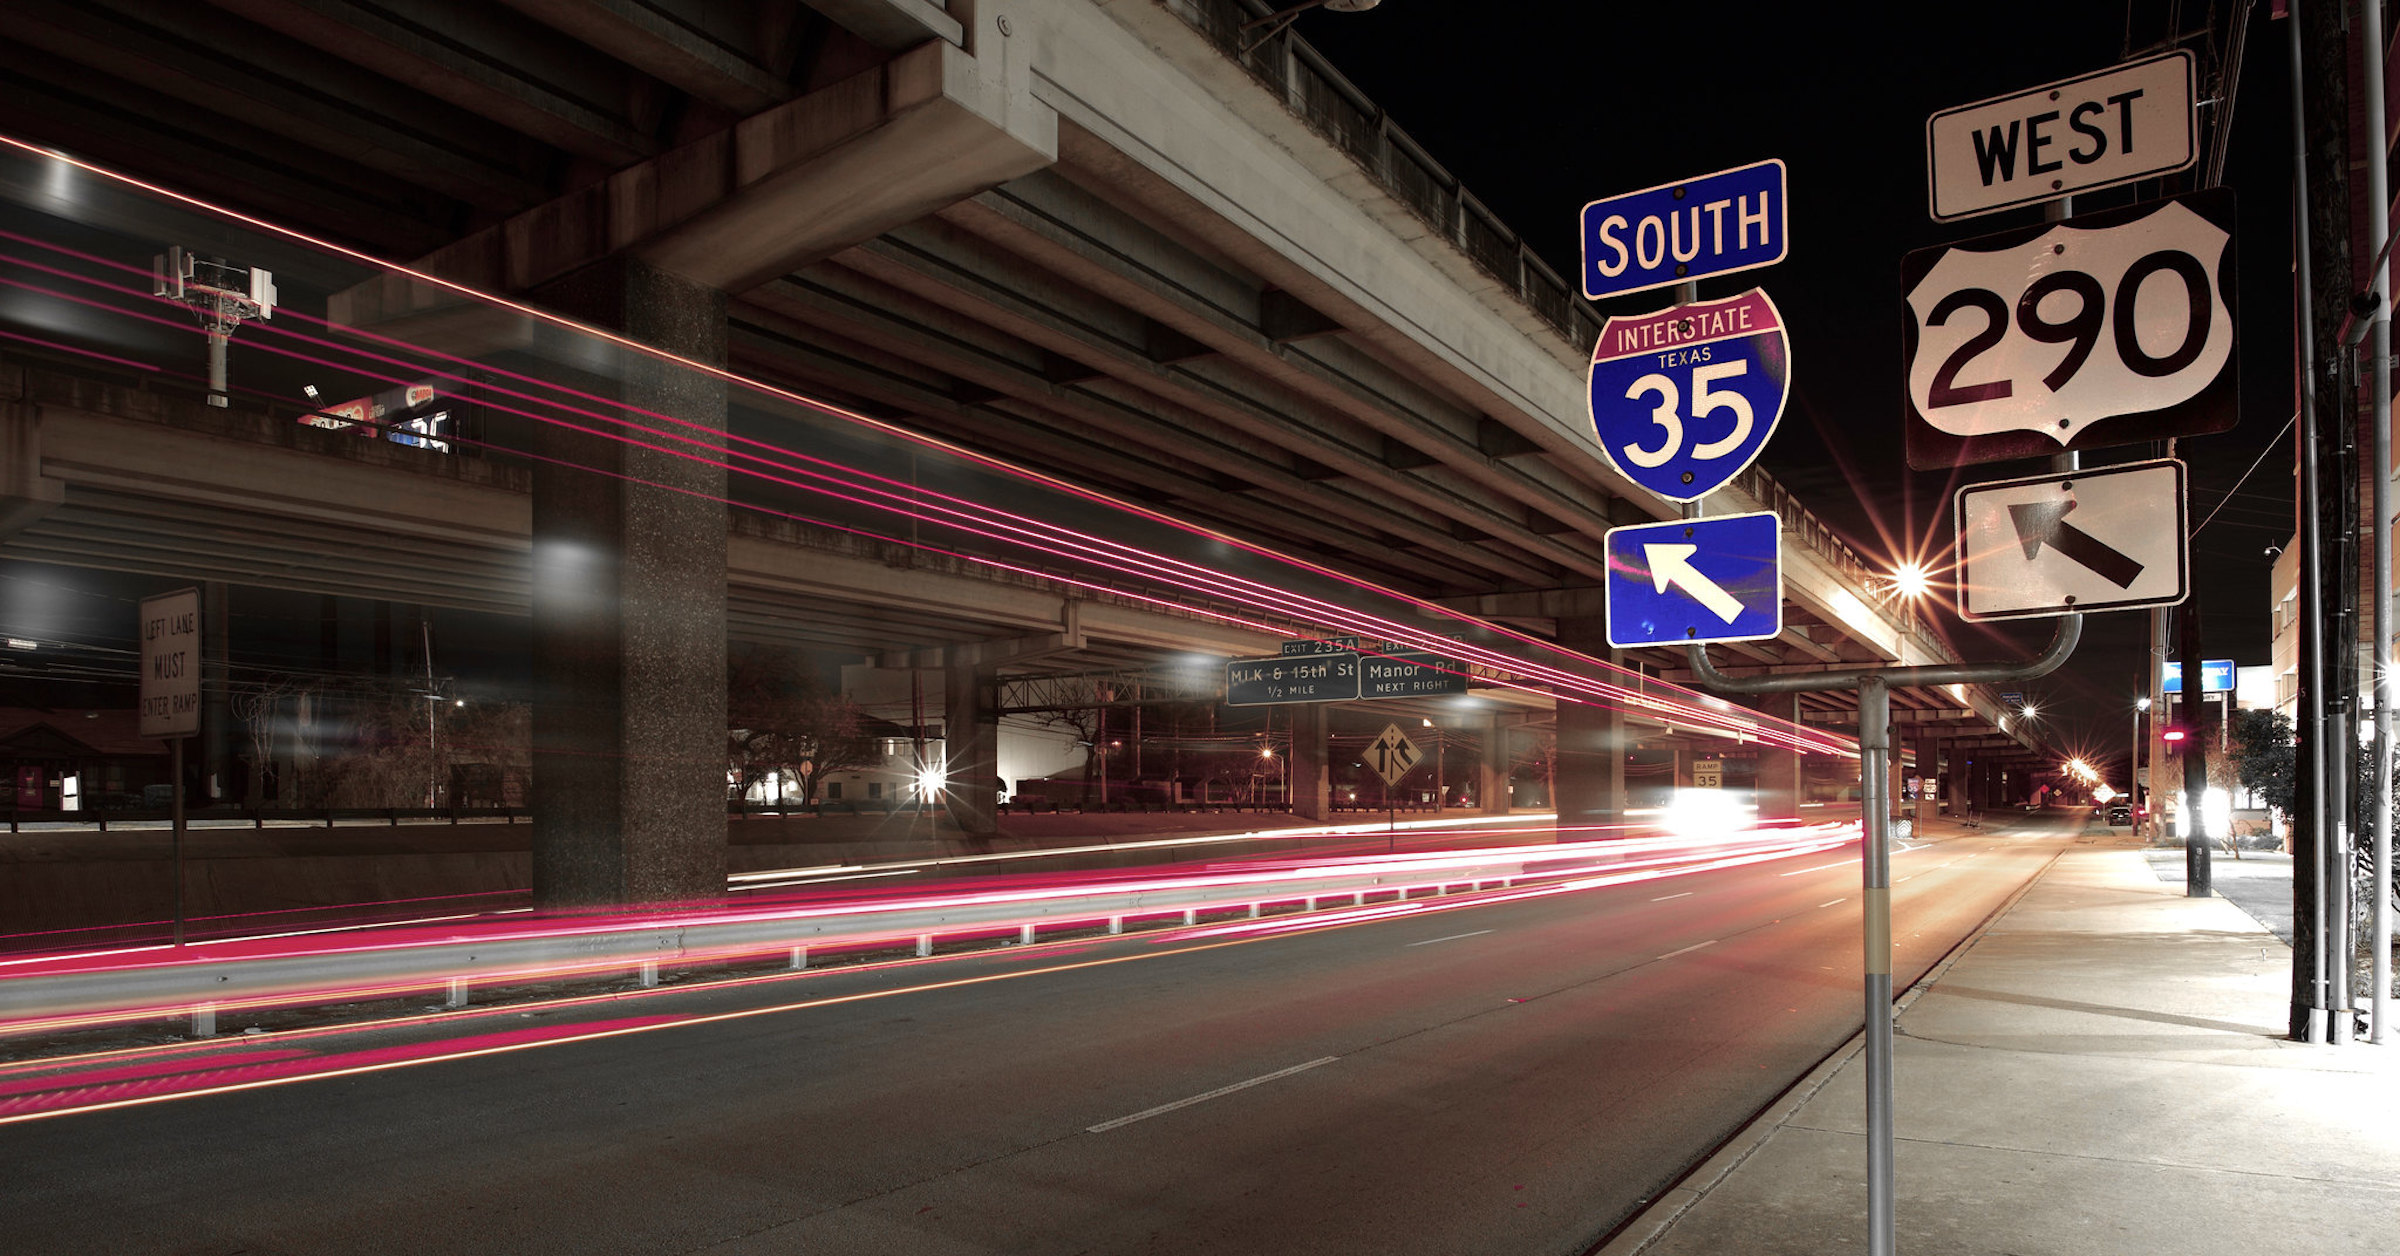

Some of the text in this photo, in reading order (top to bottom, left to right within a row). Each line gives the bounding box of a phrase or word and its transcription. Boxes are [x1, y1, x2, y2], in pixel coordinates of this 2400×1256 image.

[1971, 88, 2144, 187] WEST
[1597, 190, 1770, 278] SOUTH
[1617, 305, 1753, 352] INTERSTATE
[1925, 249, 2213, 410] 290
[1657, 347, 1712, 369] TEXAS
[1623, 358, 1754, 468] 35
[145, 612, 195, 641] LEFT LANE
[1284, 638, 1356, 654] EXIT 235A
[154, 651, 186, 681] MUST
[1231, 662, 1354, 683] MLK & 15th St
[1370, 660, 1456, 679] Manor Rd
[1289, 684, 1315, 695] MILE
[1376, 680, 1450, 693] NEXT RIGHT
[142, 692, 198, 718] ENTER RAMP
[1698, 775, 1717, 787] 35
